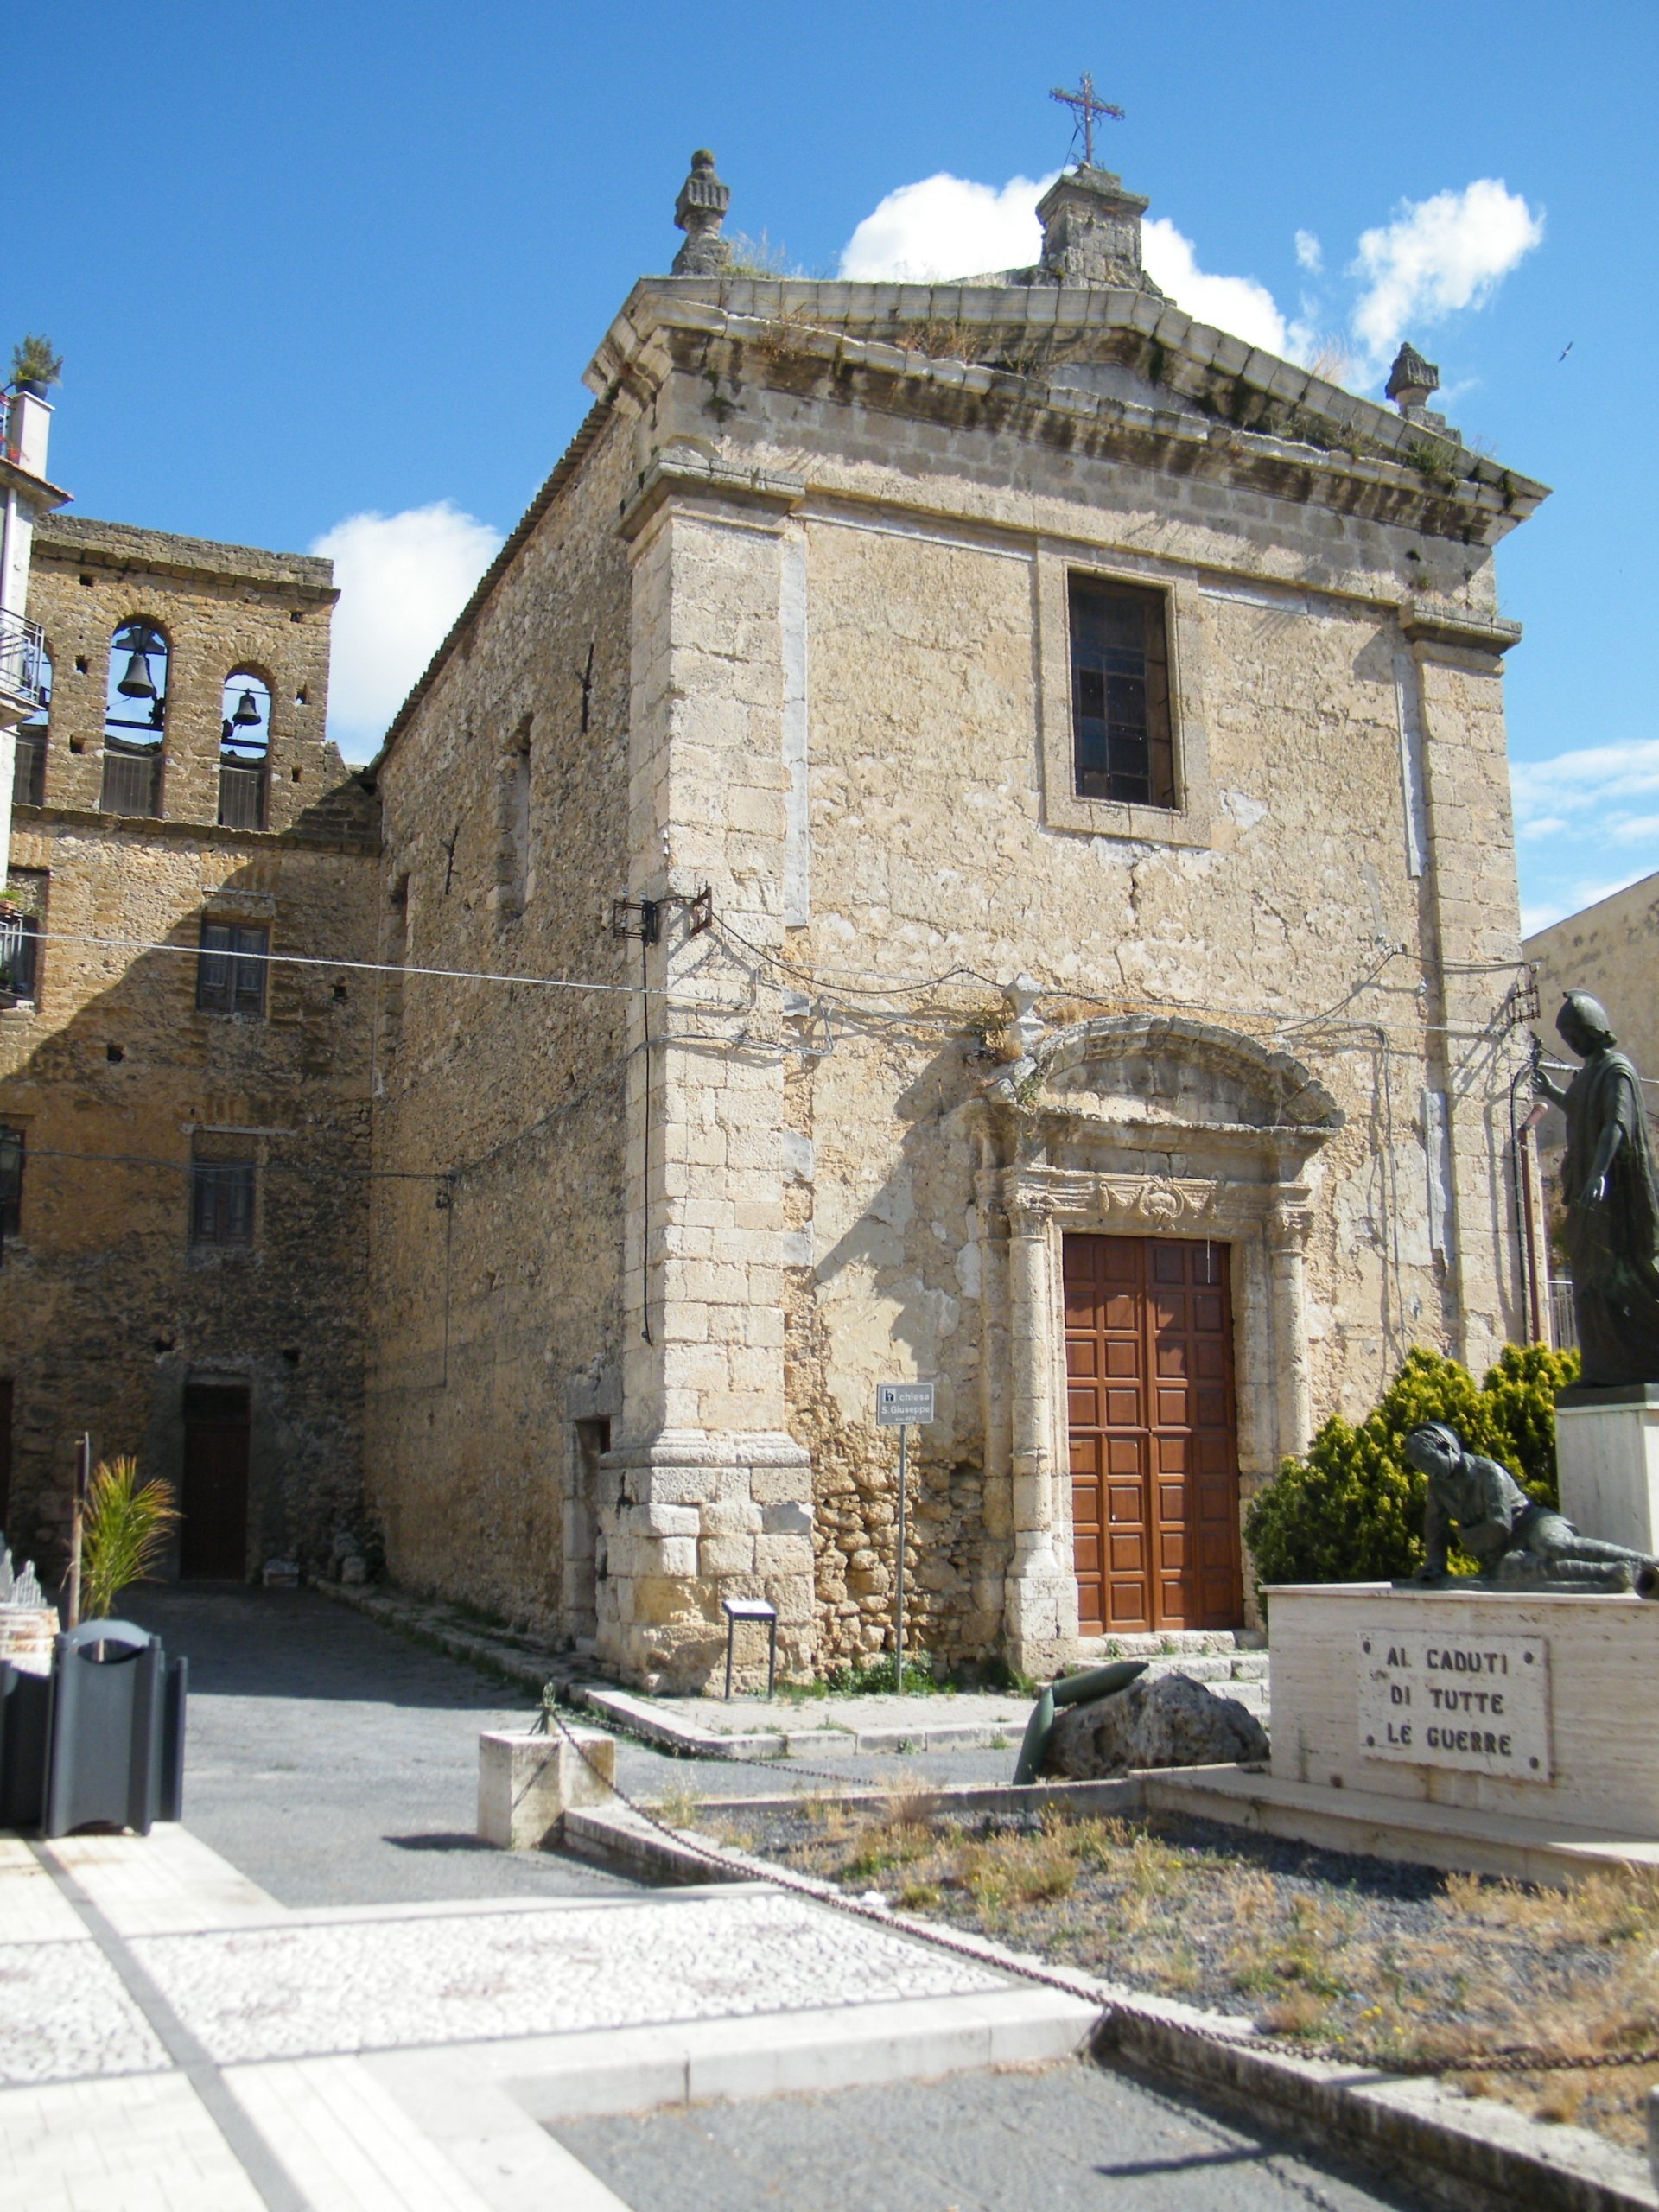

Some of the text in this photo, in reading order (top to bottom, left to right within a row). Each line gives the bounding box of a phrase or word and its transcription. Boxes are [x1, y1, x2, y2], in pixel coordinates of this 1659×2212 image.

[899, 1392, 930, 1402] chiesa
[1427, 1649, 1508, 1674] CADUTI
[1391, 1685, 1504, 1714] DI TUTTE
[1388, 1723, 1511, 1757] LE GUERRE
